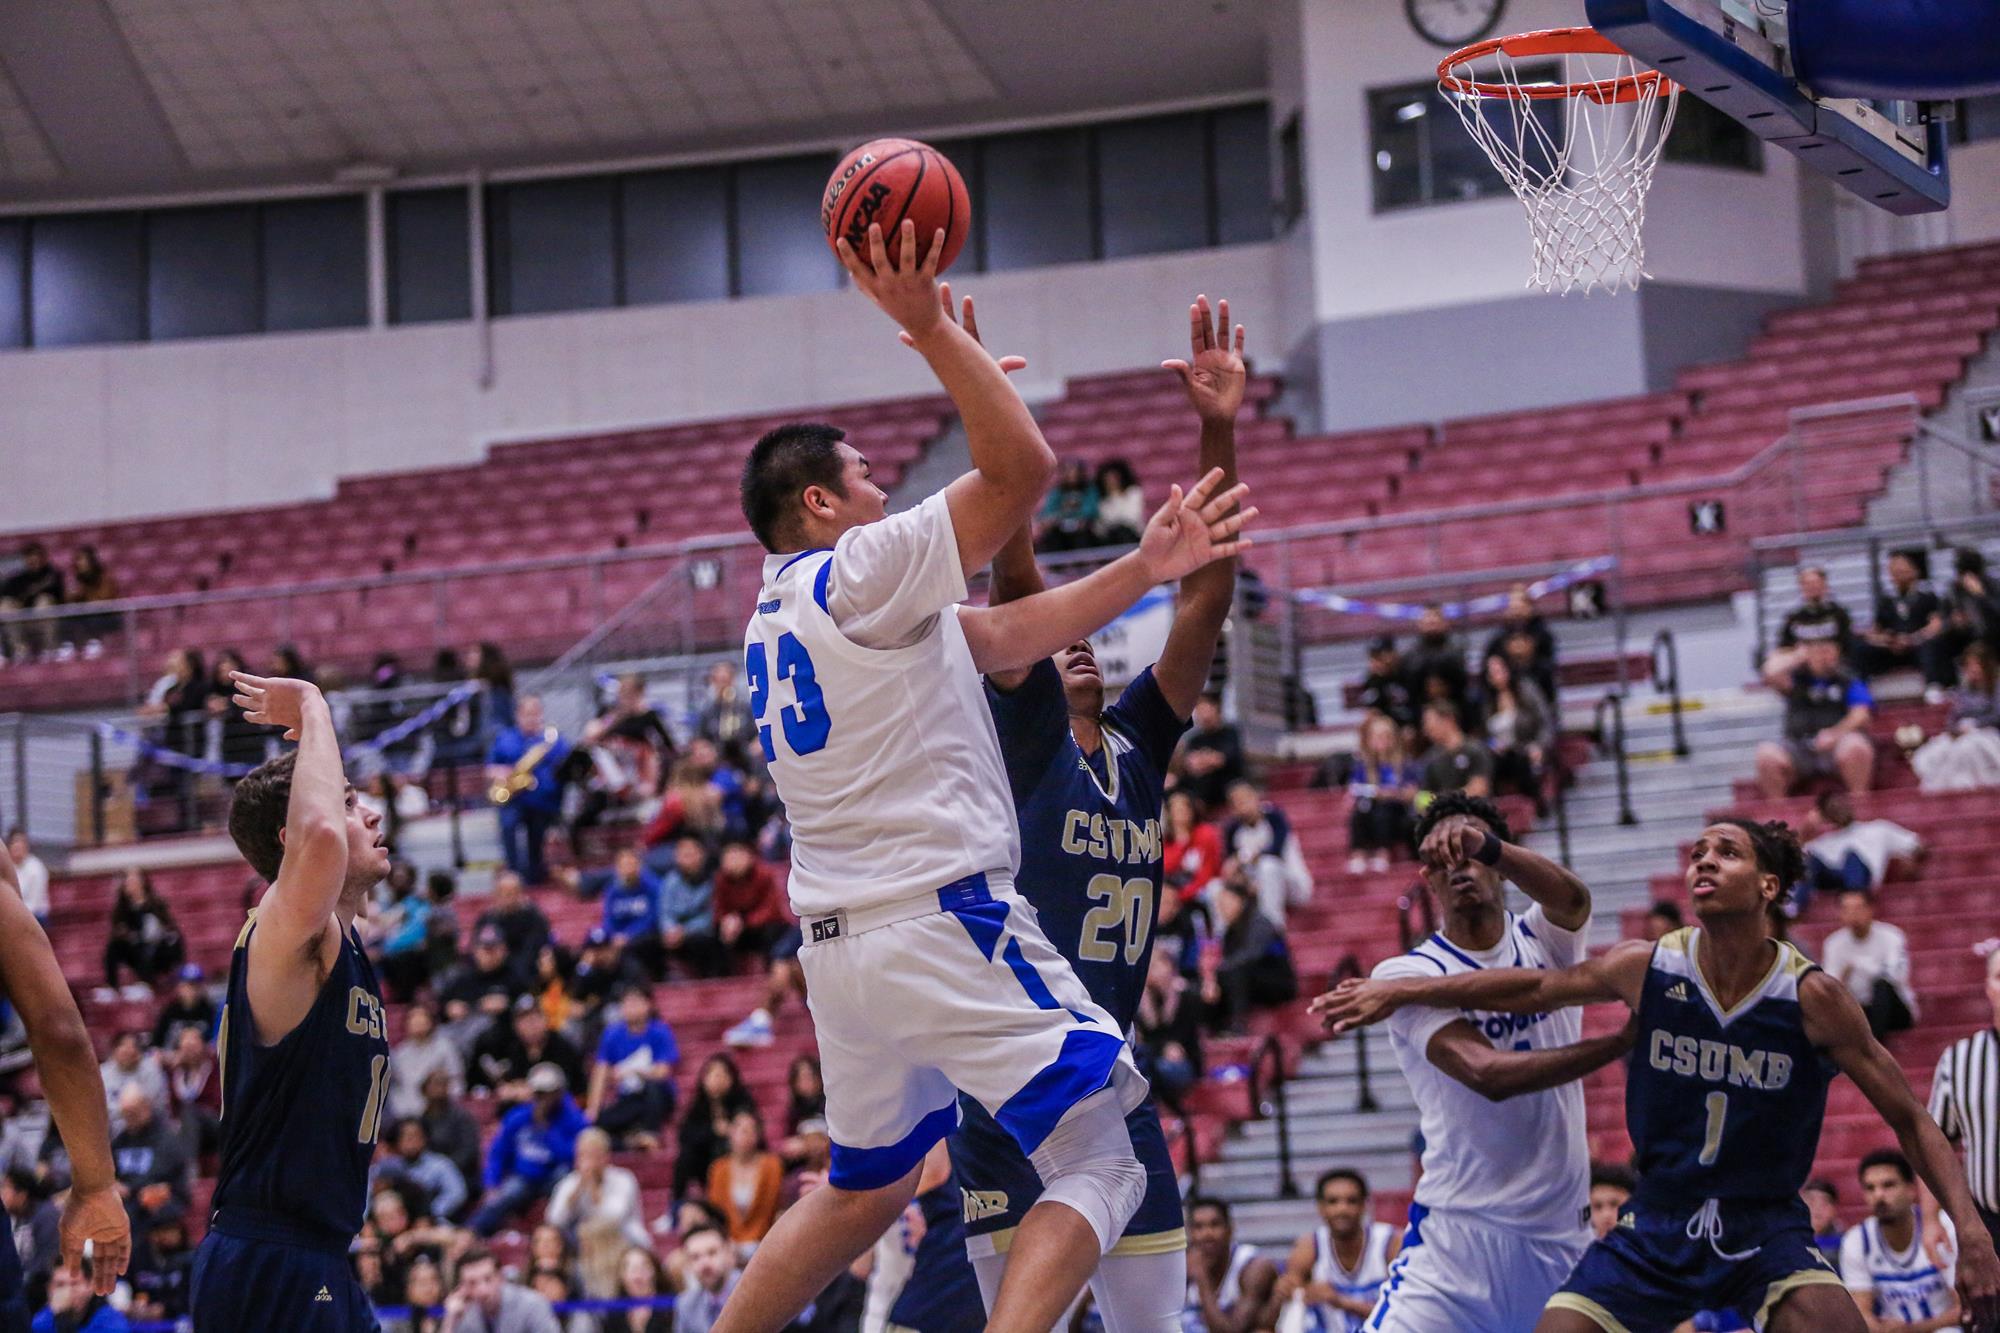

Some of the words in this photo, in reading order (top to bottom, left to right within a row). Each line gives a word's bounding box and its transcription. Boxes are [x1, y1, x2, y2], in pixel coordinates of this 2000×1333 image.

[844, 181, 891, 252] NCAA
[745, 631, 832, 763] 23
[1078, 873, 1153, 966] 20
[1649, 1028, 1793, 1091] CSUMB
[1698, 1090, 1729, 1166] 1
